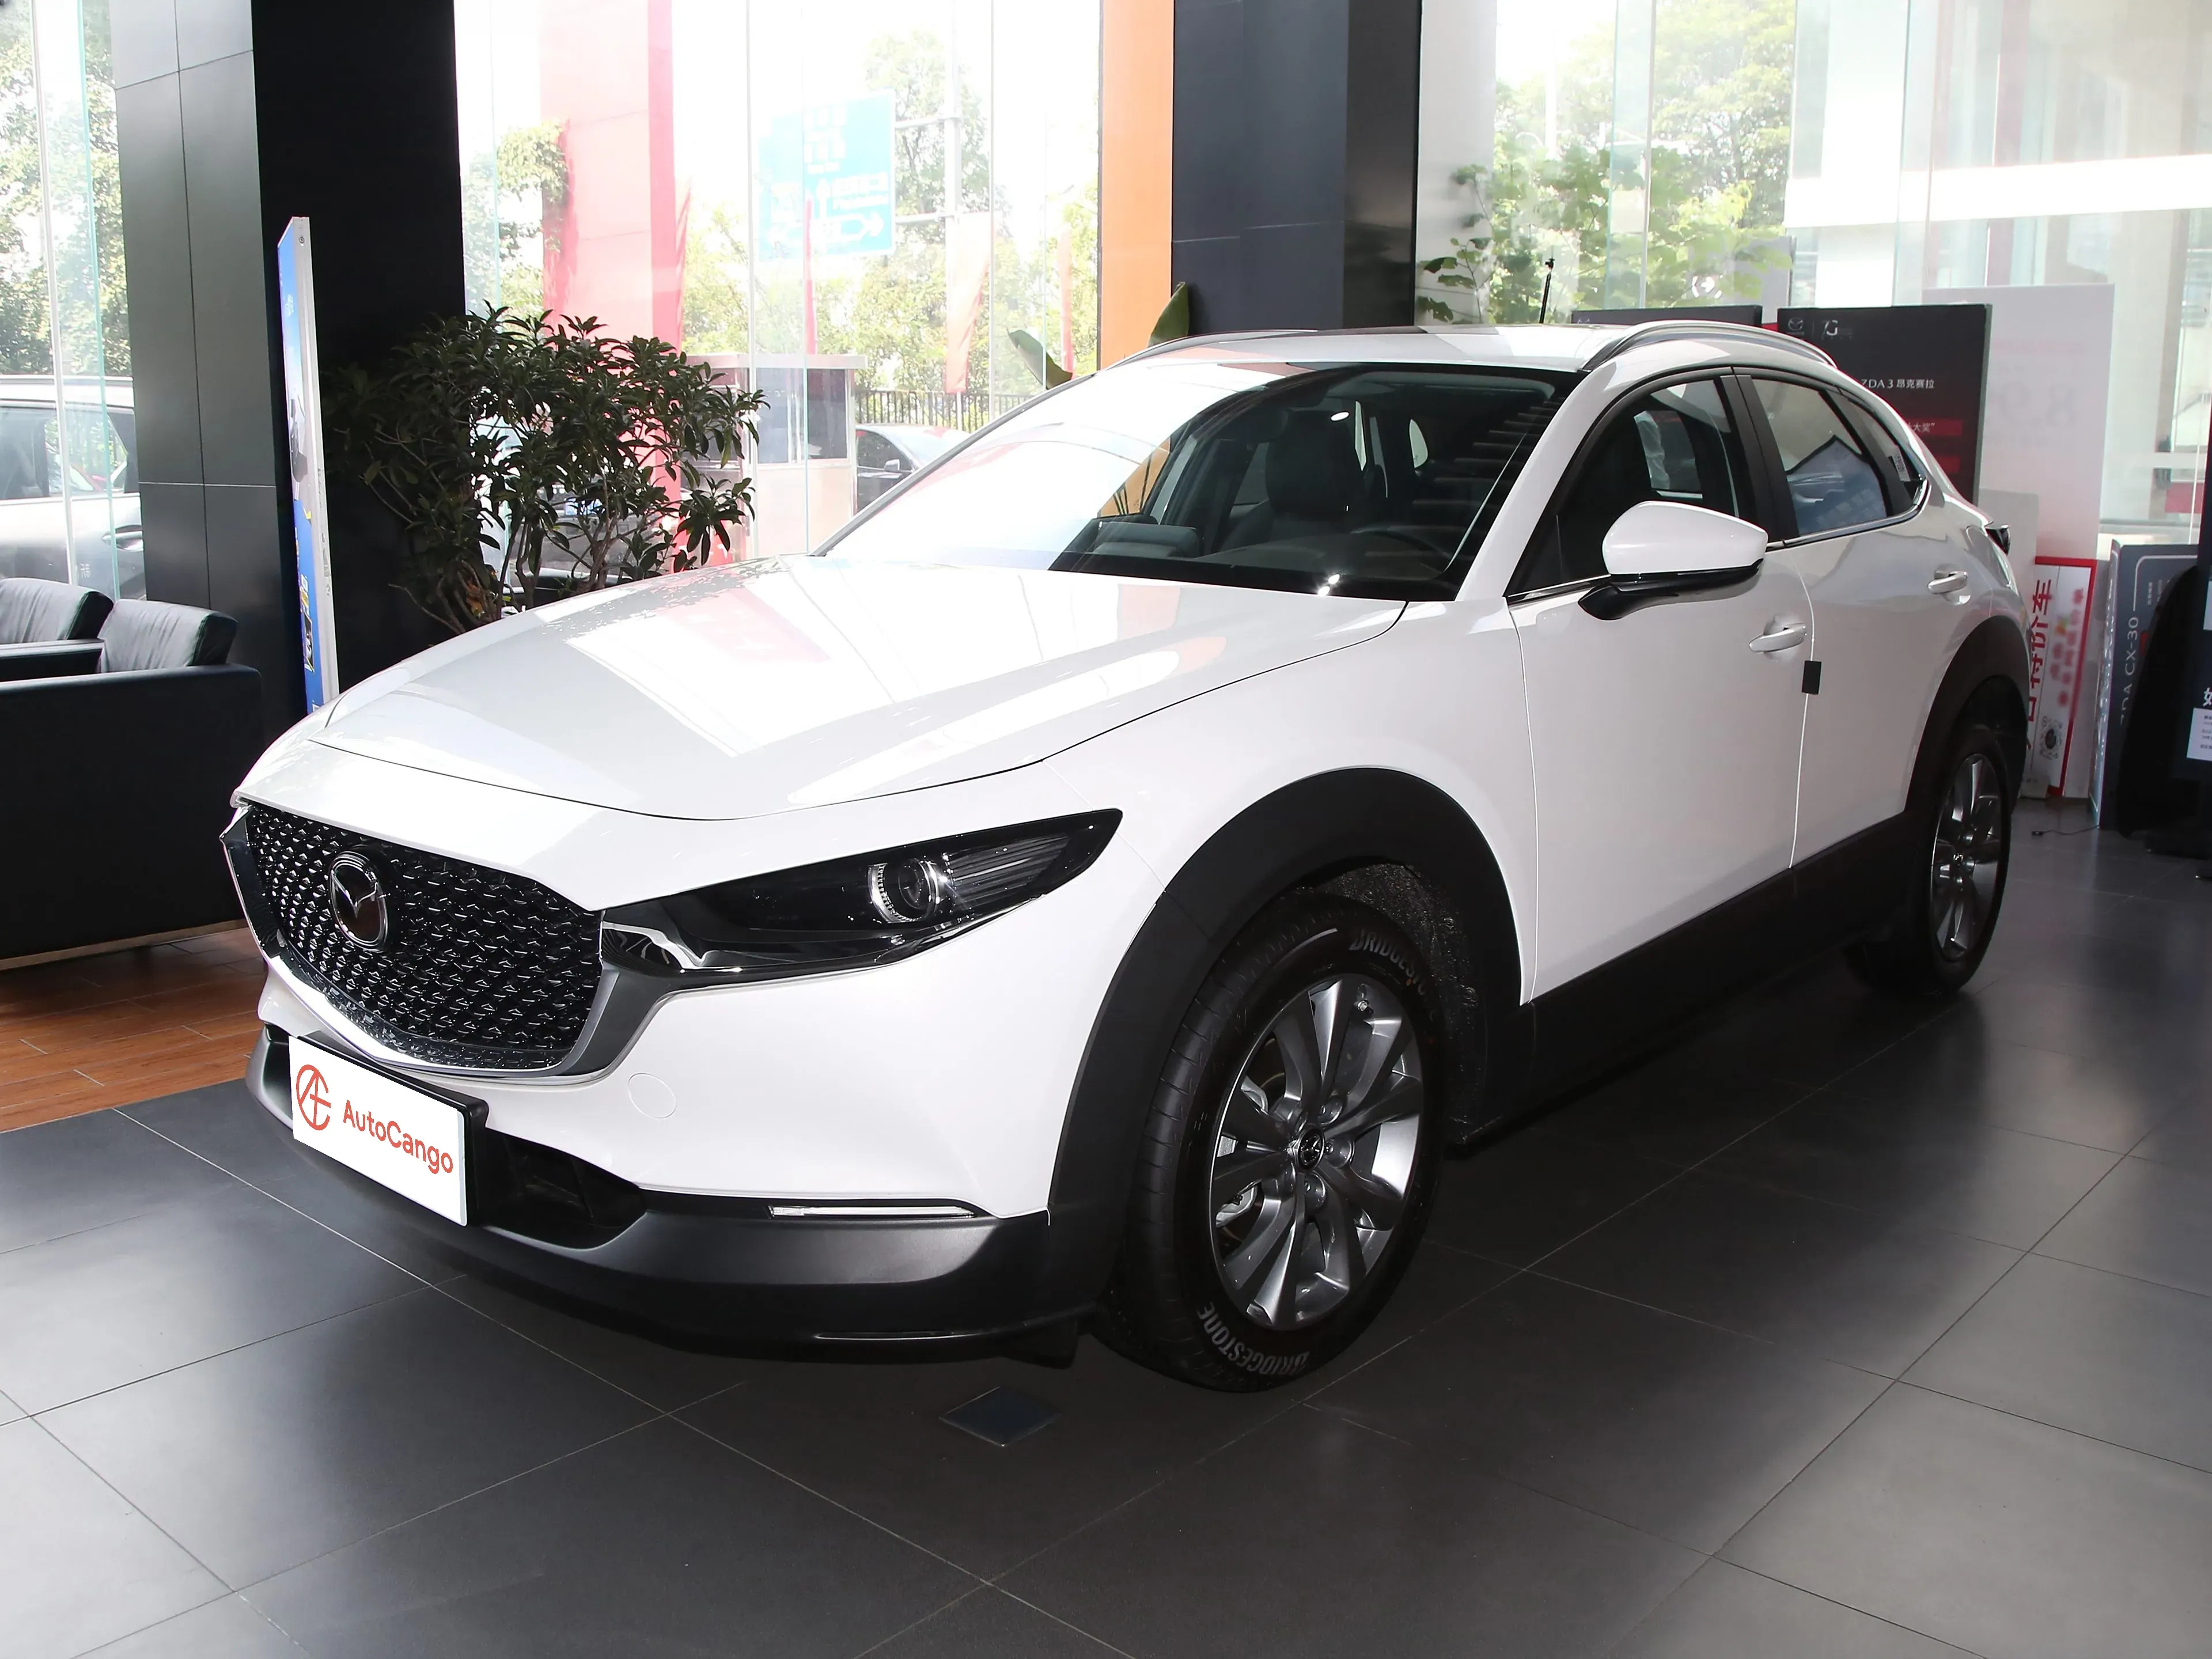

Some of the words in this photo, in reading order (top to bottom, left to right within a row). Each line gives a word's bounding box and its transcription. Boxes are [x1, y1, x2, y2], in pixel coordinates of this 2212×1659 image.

[1887, 378, 1894, 389] 3
[1896, 378, 1936, 389] 昂克赛拉
[2124, 616, 2139, 676] CX-30
[1196, 1301, 1310, 1376] BRIDGESTONE
